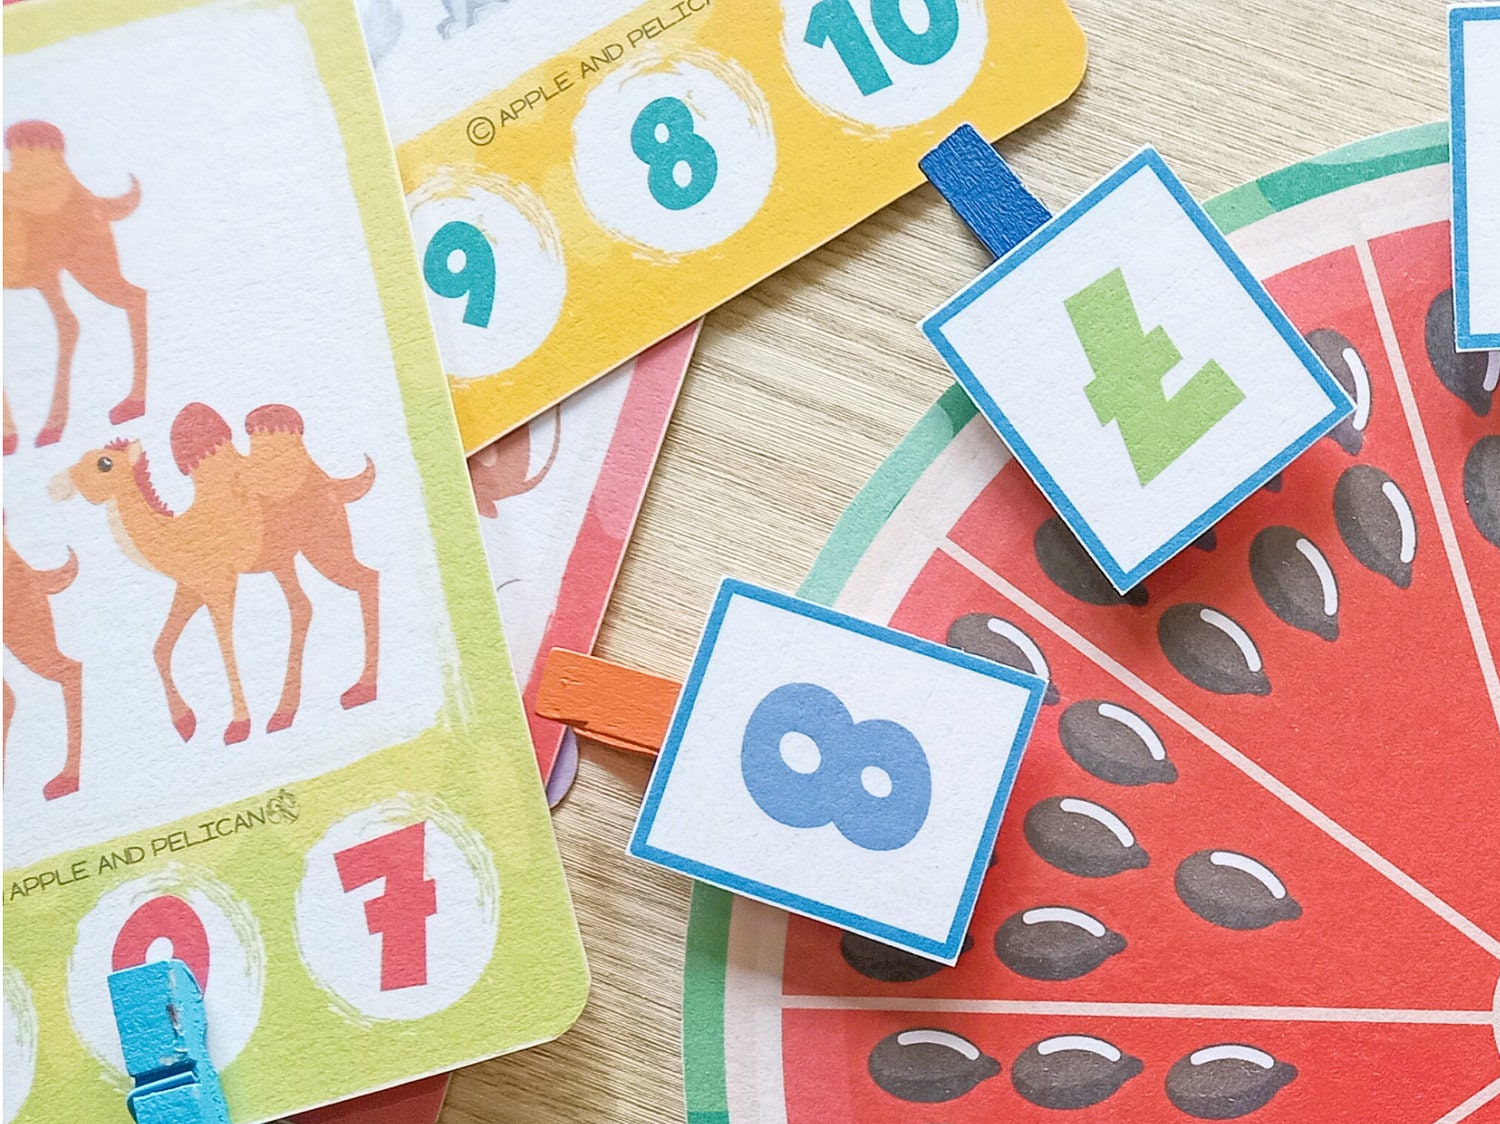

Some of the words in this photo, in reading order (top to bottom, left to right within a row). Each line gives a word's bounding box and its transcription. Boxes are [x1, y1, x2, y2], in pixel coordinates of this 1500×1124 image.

[499, 73, 575, 128] APPLE
[579, 43, 625, 82] AND
[626, 0, 711, 48] PELIC
[803, 0, 959, 97] 10
[632, 97, 717, 210] 8
[425, 222, 495, 327] 9
[1063, 266, 1247, 487] 7
[742, 684, 931, 851] 8
[9, 860, 91, 901] APPLE
[98, 846, 145, 875] AND
[151, 811, 269, 857] PELICAN
[335, 822, 436, 990] 7
